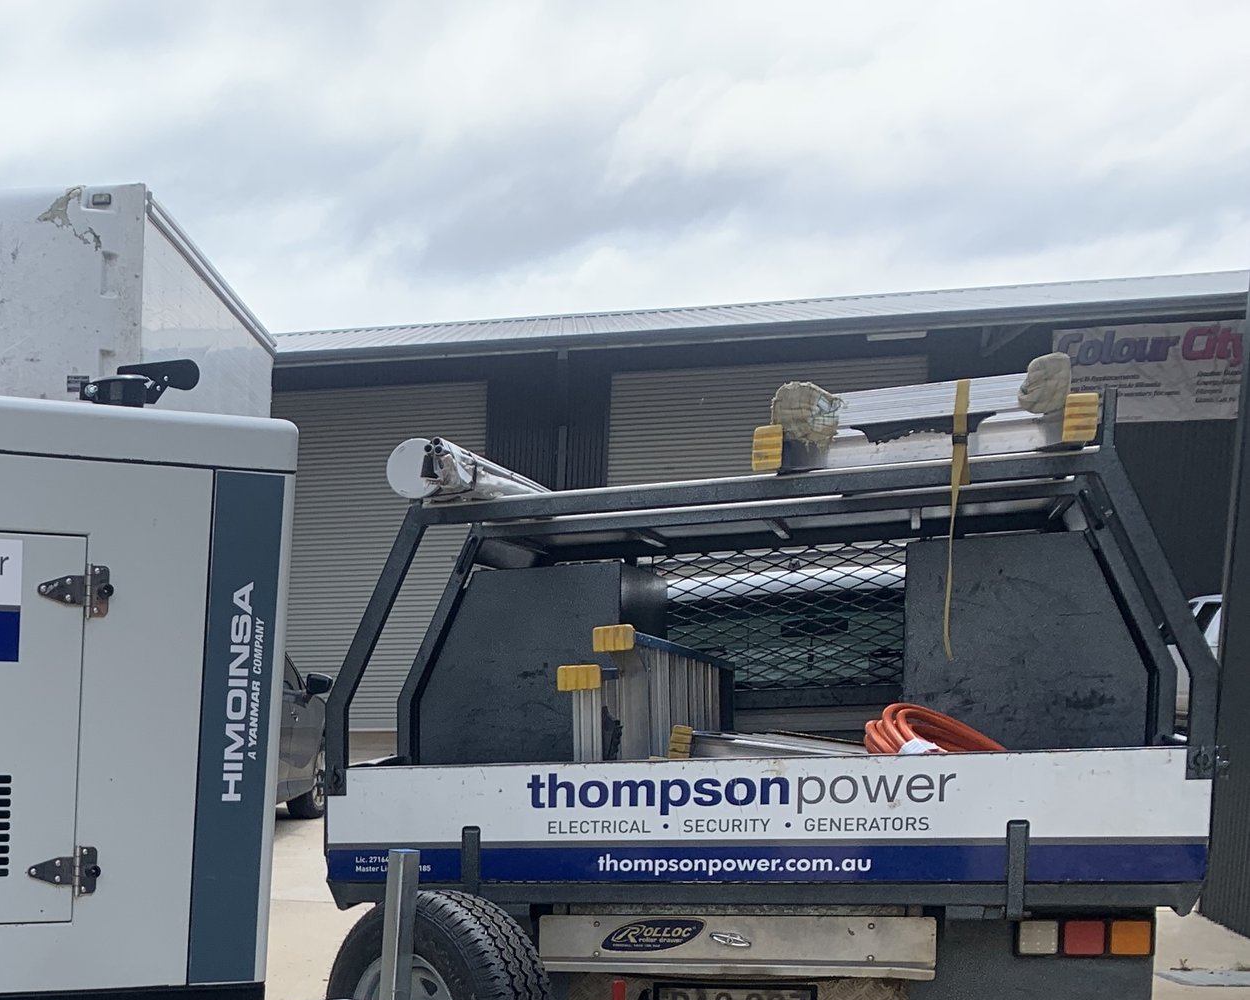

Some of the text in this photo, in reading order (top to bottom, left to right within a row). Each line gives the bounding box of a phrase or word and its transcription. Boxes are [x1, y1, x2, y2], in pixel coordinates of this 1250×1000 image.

[1058, 322, 1243, 367] Colour City
[221, 581, 255, 802] HIMOINSA
[248, 617, 265, 760] A YANMAR COMPANY
[526, 770, 956, 816] thompsonpower
[547, 816, 930, 835] ELECTRICAL SECURITY GENERATORS
[598, 854, 872, 876] thompsonpower.com.au
[612, 925, 693, 943] ROLLOC
